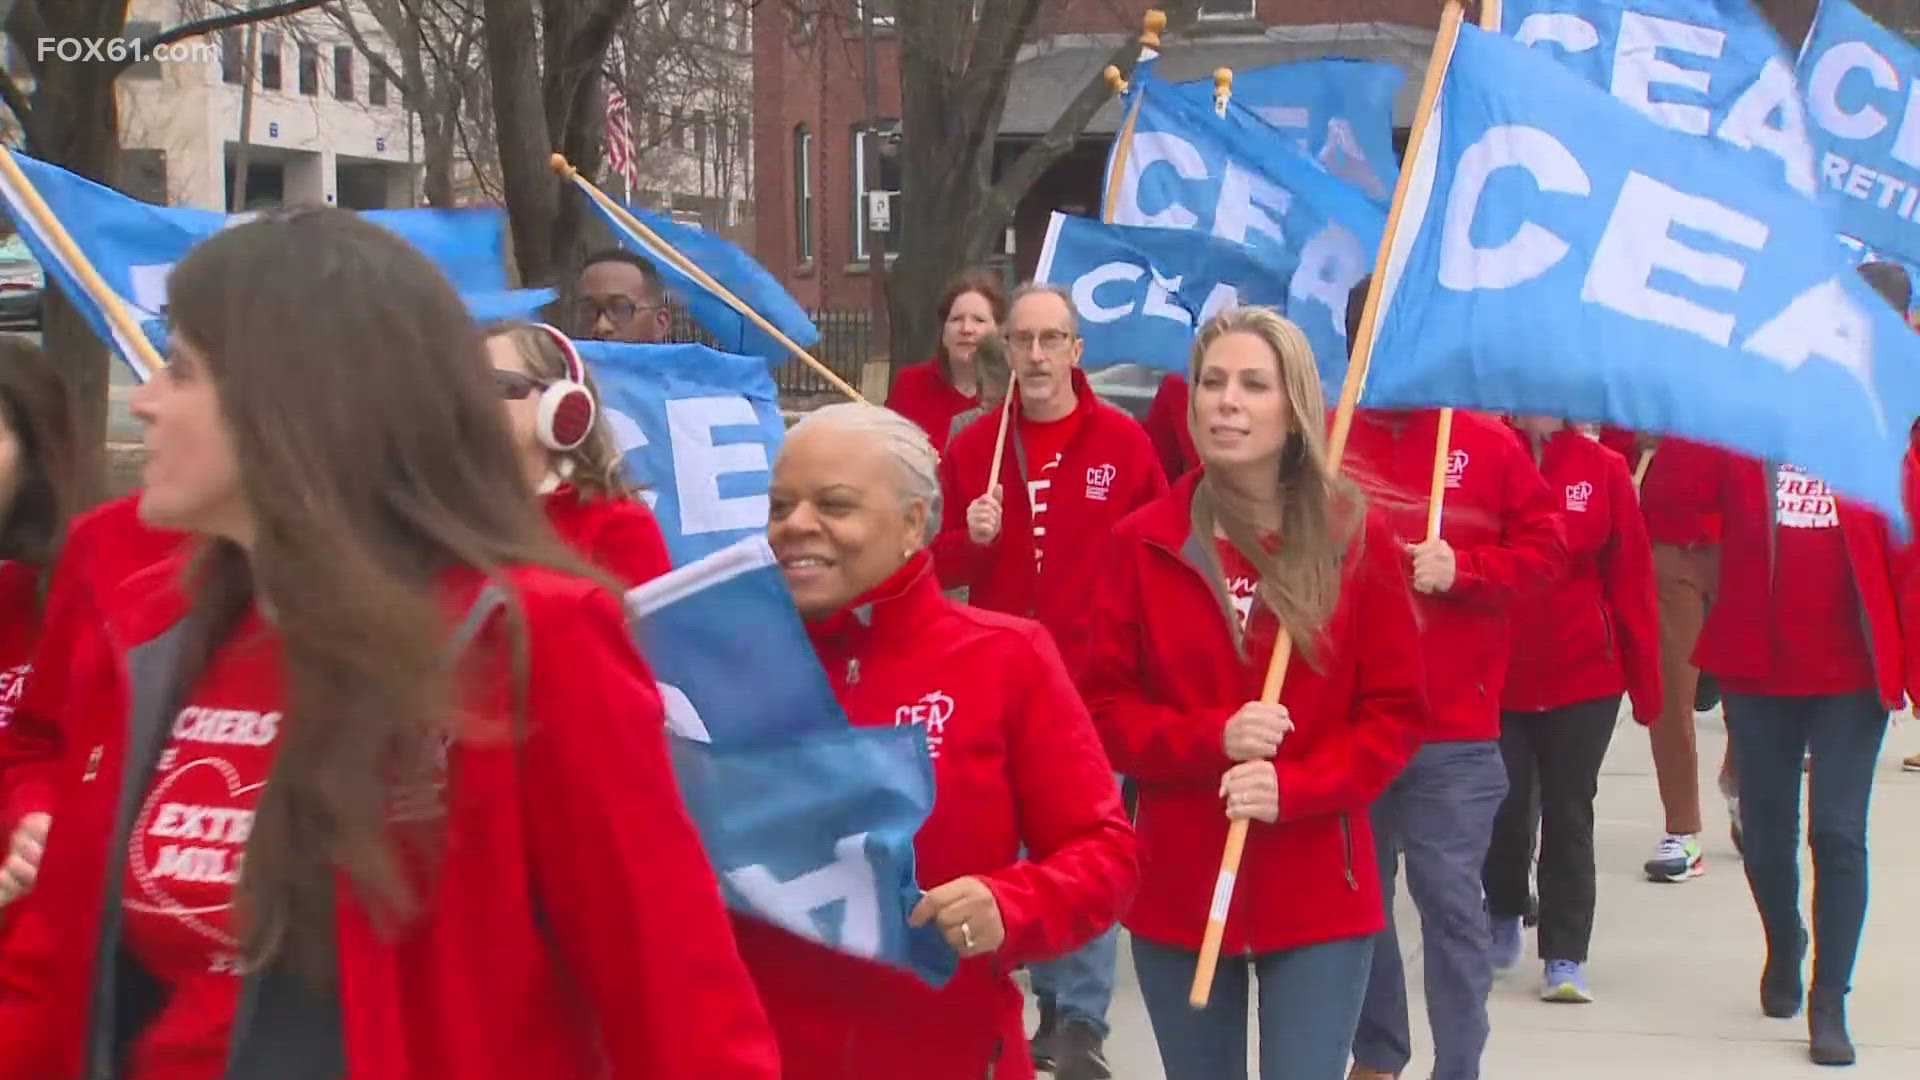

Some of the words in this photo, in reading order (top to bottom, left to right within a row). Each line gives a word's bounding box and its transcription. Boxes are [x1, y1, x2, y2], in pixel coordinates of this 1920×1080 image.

[1822, 152, 1920, 224] RETI
[1438, 124, 1888, 436] CEA
[1086, 467, 1111, 486] CEA
[1566, 484, 1589, 500] CEA
[172, 706, 283, 746] CHERS
